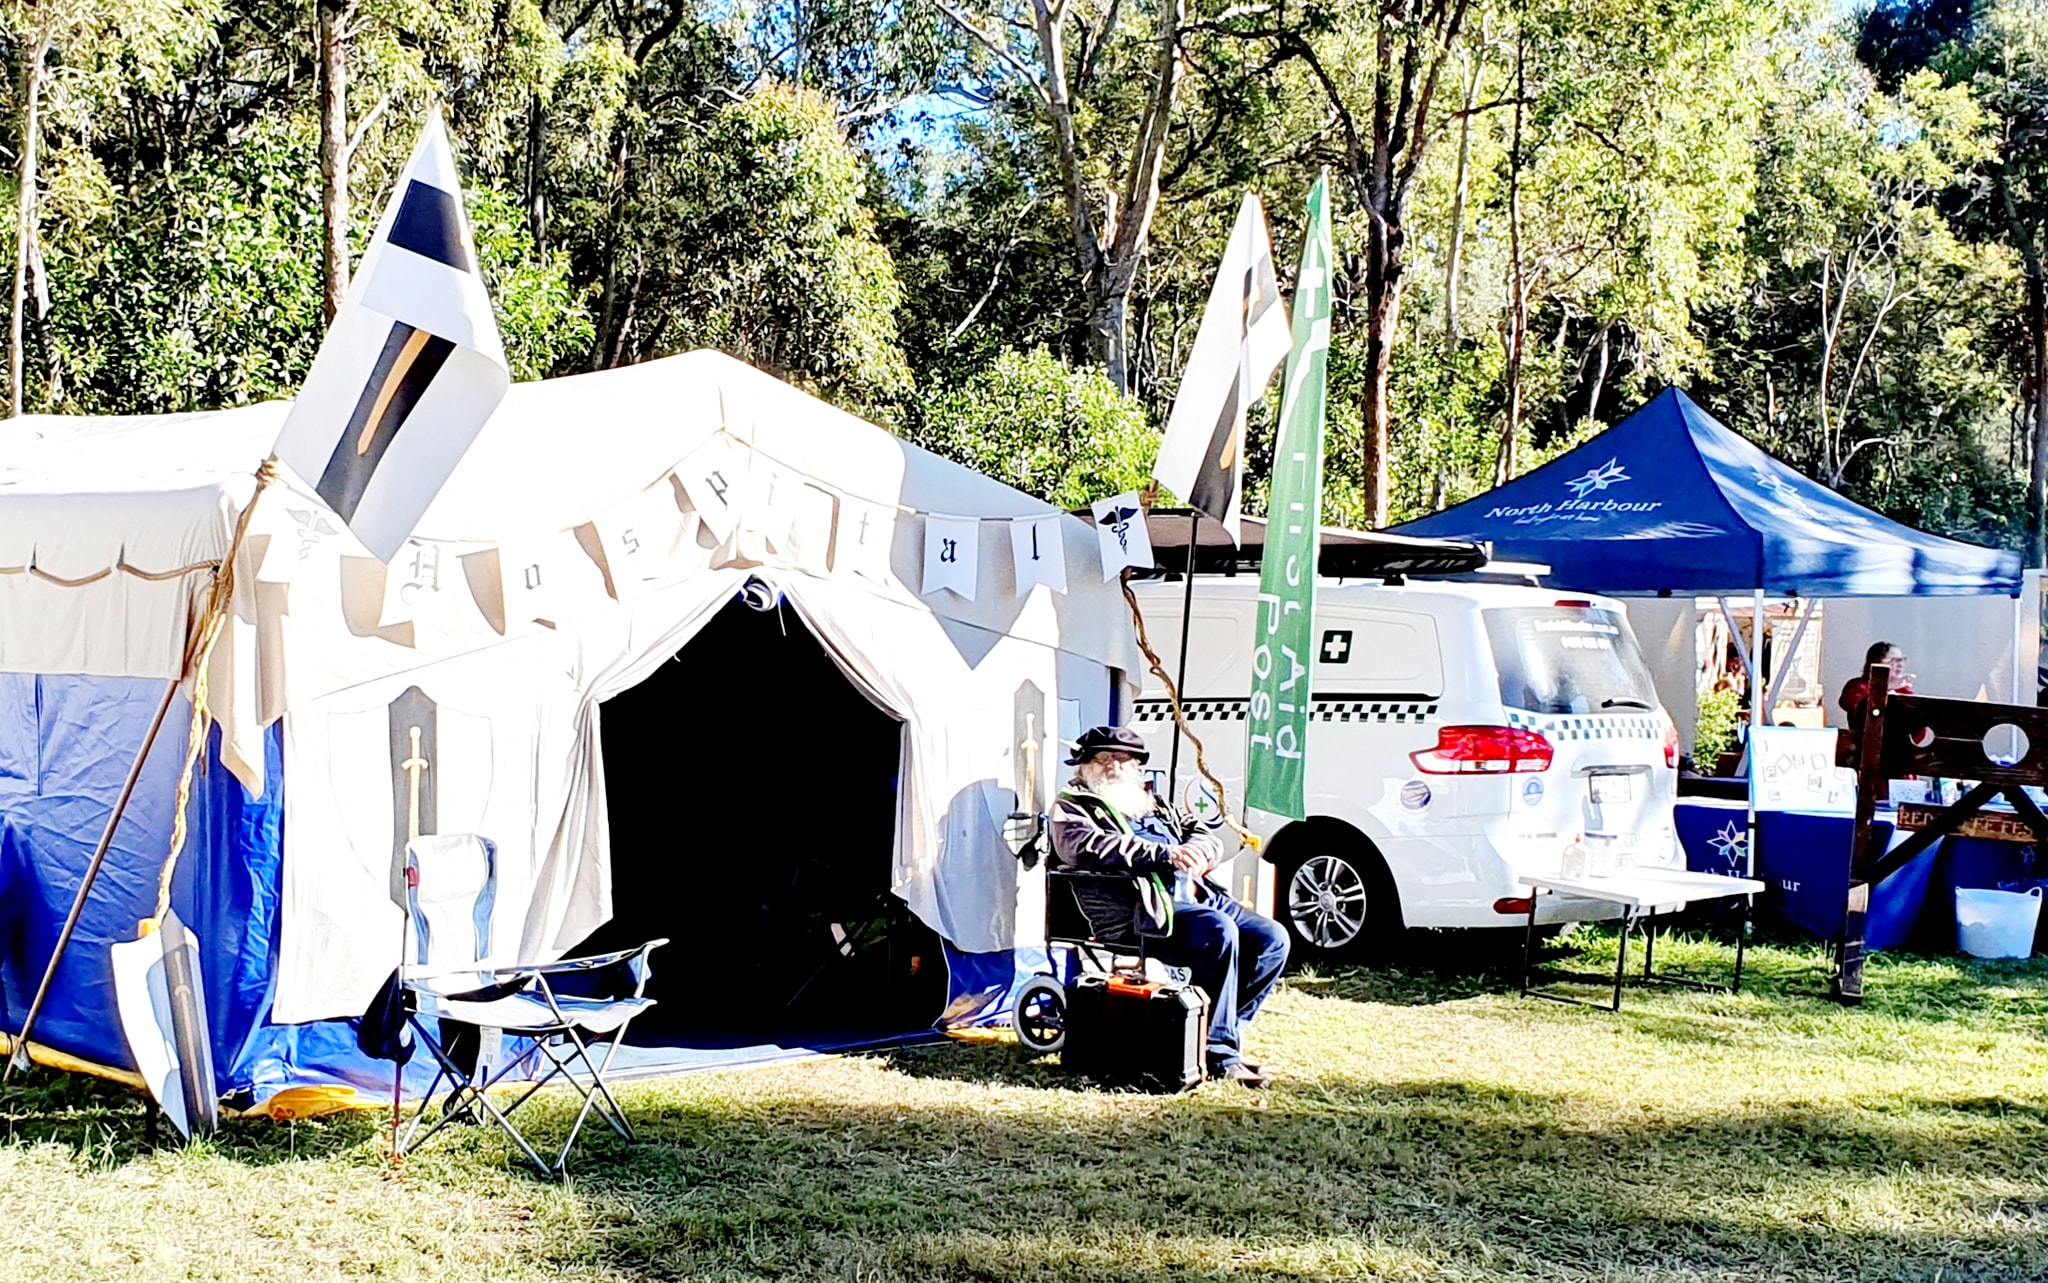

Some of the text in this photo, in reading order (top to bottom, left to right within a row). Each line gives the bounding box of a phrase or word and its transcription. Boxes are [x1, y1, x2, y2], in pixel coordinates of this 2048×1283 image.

[1483, 502, 1553, 519] North
[1554, 498, 1663, 513] Harbour
[1250, 592, 1281, 752] Post
[1275, 644, 1307, 760] Aid
